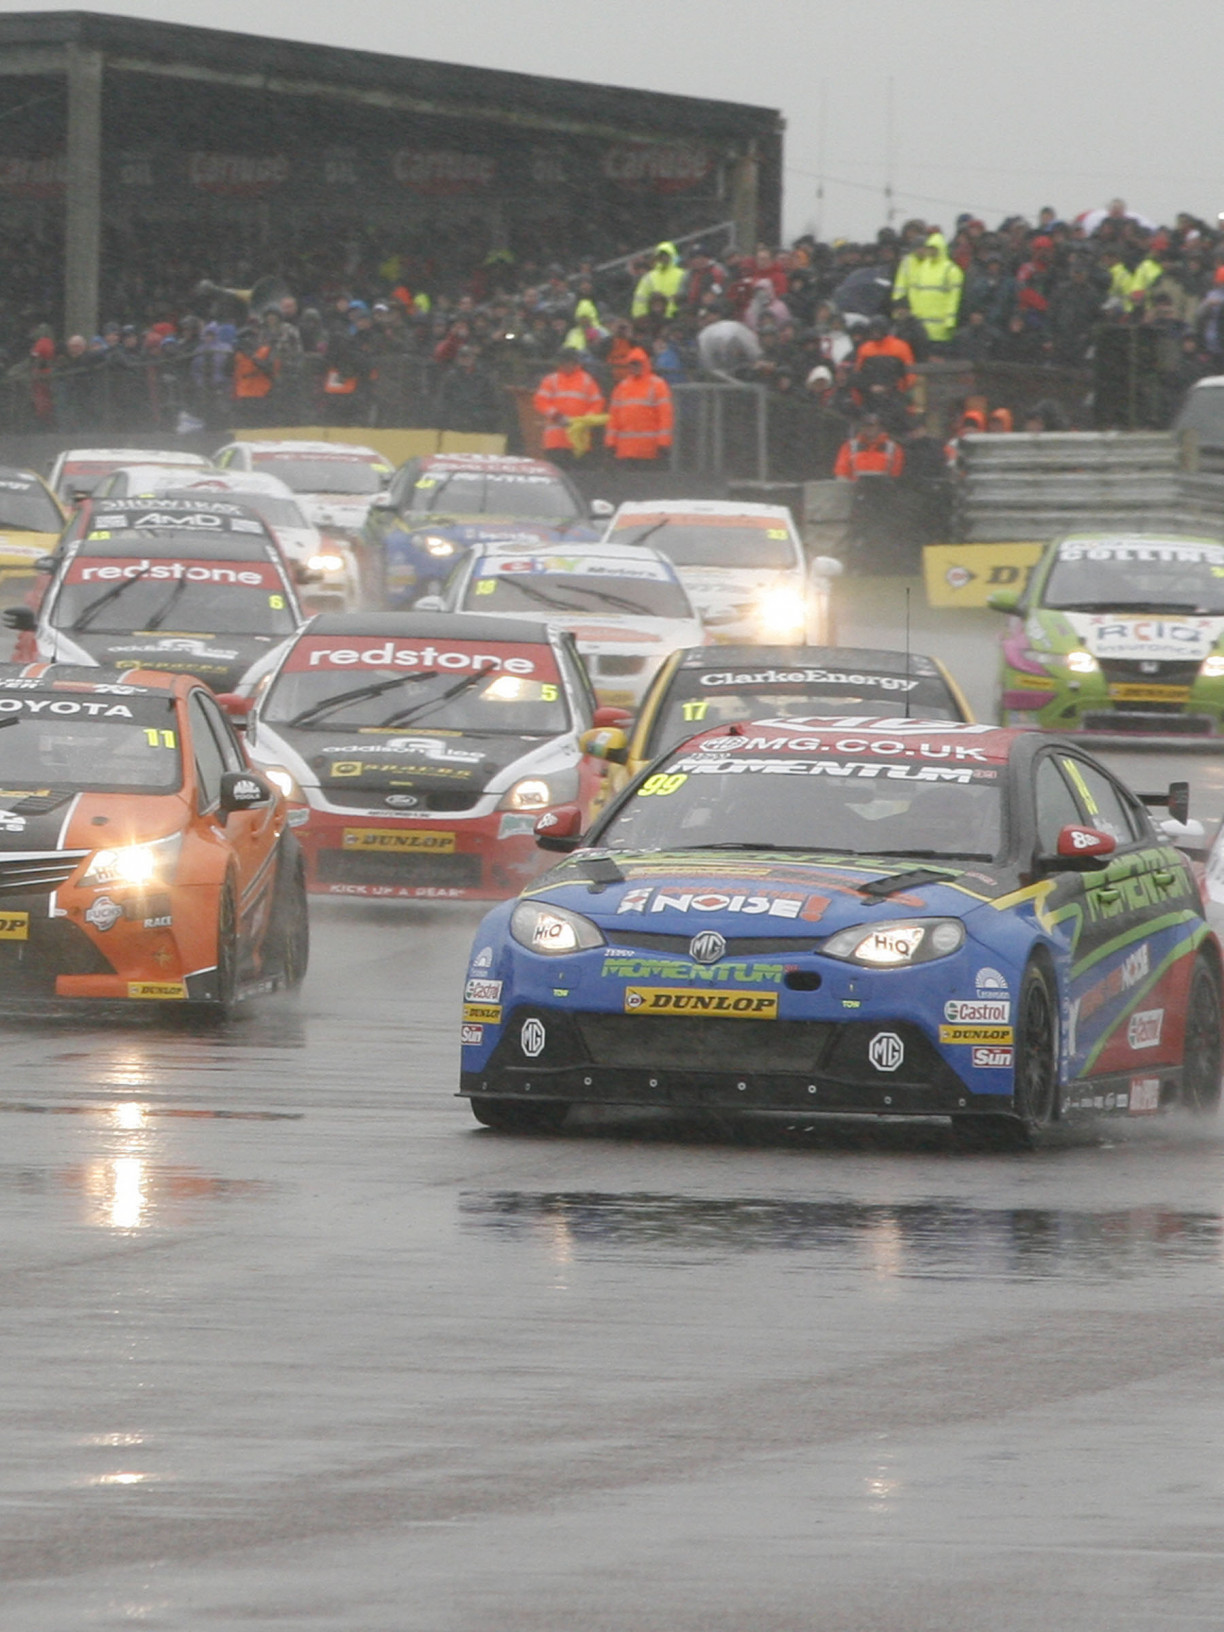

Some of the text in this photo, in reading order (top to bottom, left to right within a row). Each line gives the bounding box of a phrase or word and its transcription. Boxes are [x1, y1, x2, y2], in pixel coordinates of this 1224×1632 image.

[82, 560, 262, 585] redstone
[268, 595, 285, 609] 6
[309, 643, 534, 674] redstone
[700, 670, 919, 691] ClarkeEnergy
[541, 684, 559, 701] 5
[682, 703, 709, 721] 17
[143, 728, 176, 748] 11
[745, 738, 989, 769] MG.CO.UK
[664, 759, 974, 784] MOMENTUM
[637, 773, 688, 797] 99
[362, 837, 455, 850] DUNLOP
[143, 915, 173, 928] RACE
[534, 923, 563, 941] HiQ
[692, 935, 723, 961] MG
[874, 935, 910, 956] HiQ
[602, 958, 783, 984] MOMENTUM
[649, 995, 777, 1012] DUNLOP
[958, 1004, 1007, 1022] Castrol
[524, 1022, 544, 1055] MG
[952, 1030, 1009, 1039] DUNLOP
[874, 1037, 901, 1067] MG
